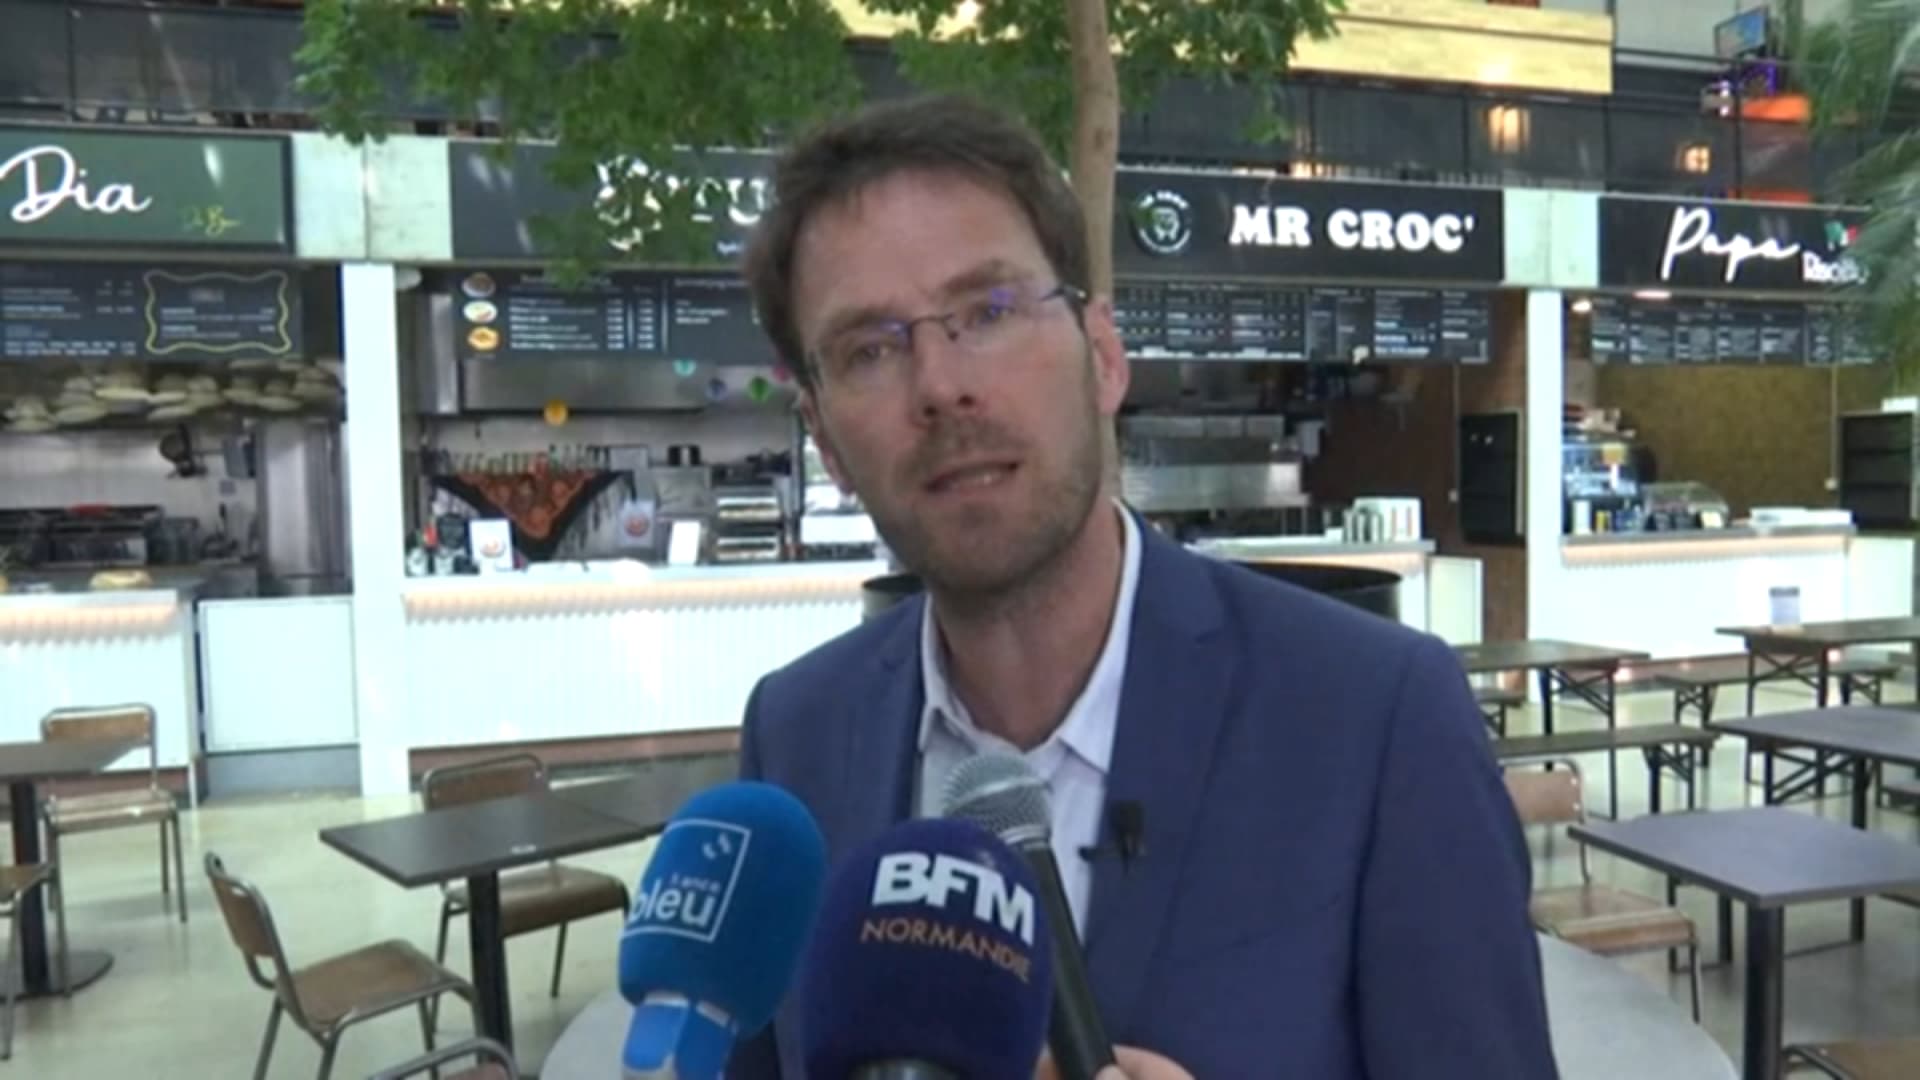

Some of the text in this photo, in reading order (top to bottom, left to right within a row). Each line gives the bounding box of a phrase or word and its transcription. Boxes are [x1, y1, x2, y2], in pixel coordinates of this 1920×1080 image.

[0, 145, 152, 221] Dia
[1229, 205, 1474, 253] MR CROC'
[1660, 206, 1799, 283] Papa
[872, 851, 1035, 944] BFM
[860, 917, 1031, 983] NORMANDIE
